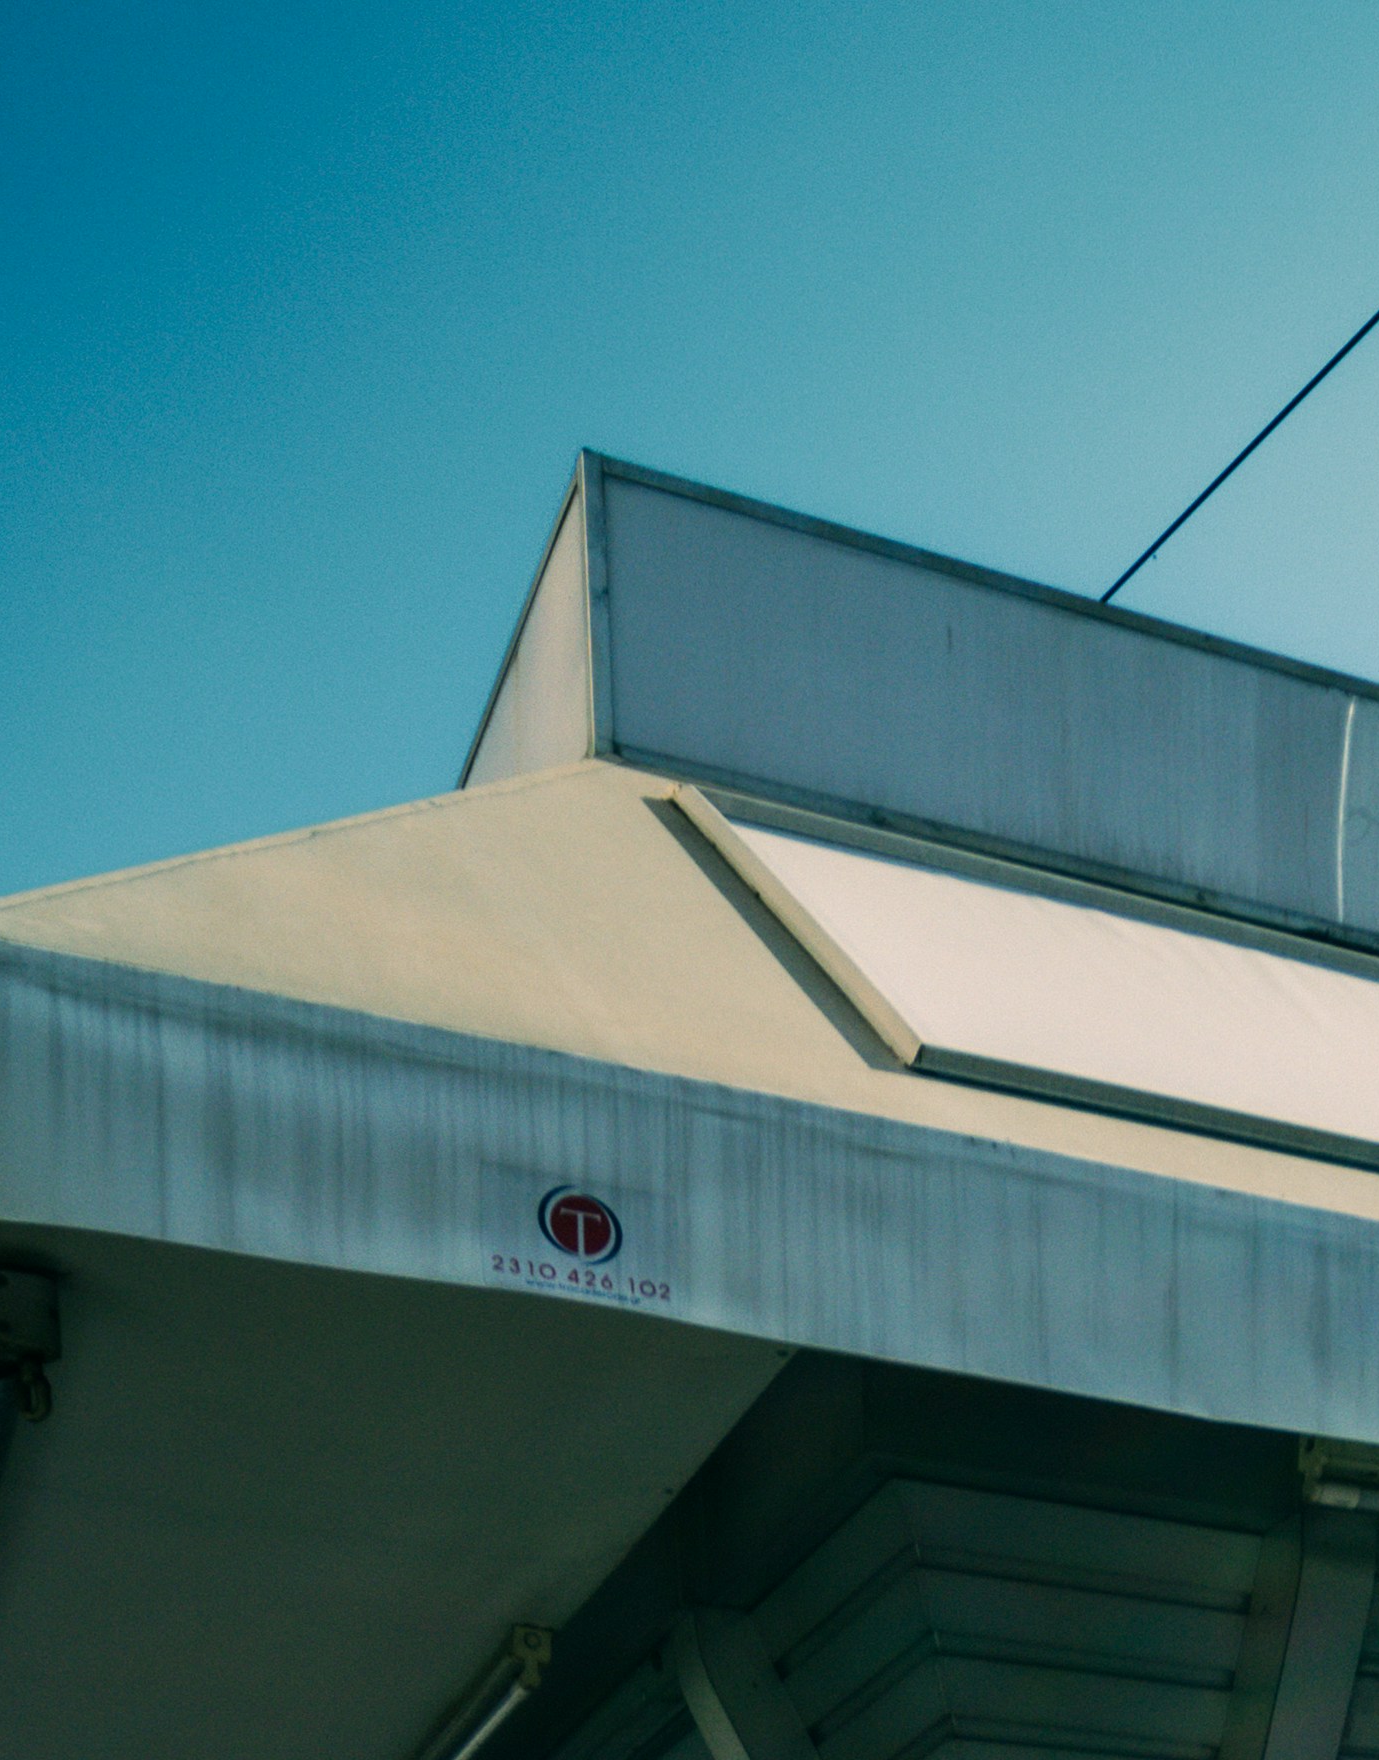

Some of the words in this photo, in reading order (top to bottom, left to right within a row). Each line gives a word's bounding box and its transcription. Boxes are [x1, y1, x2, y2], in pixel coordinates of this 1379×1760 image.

[560, 1208, 601, 1257] T
[491, 1254, 557, 1281] 2310
[567, 1268, 614, 1291] 426
[628, 1276, 671, 1302] 102
